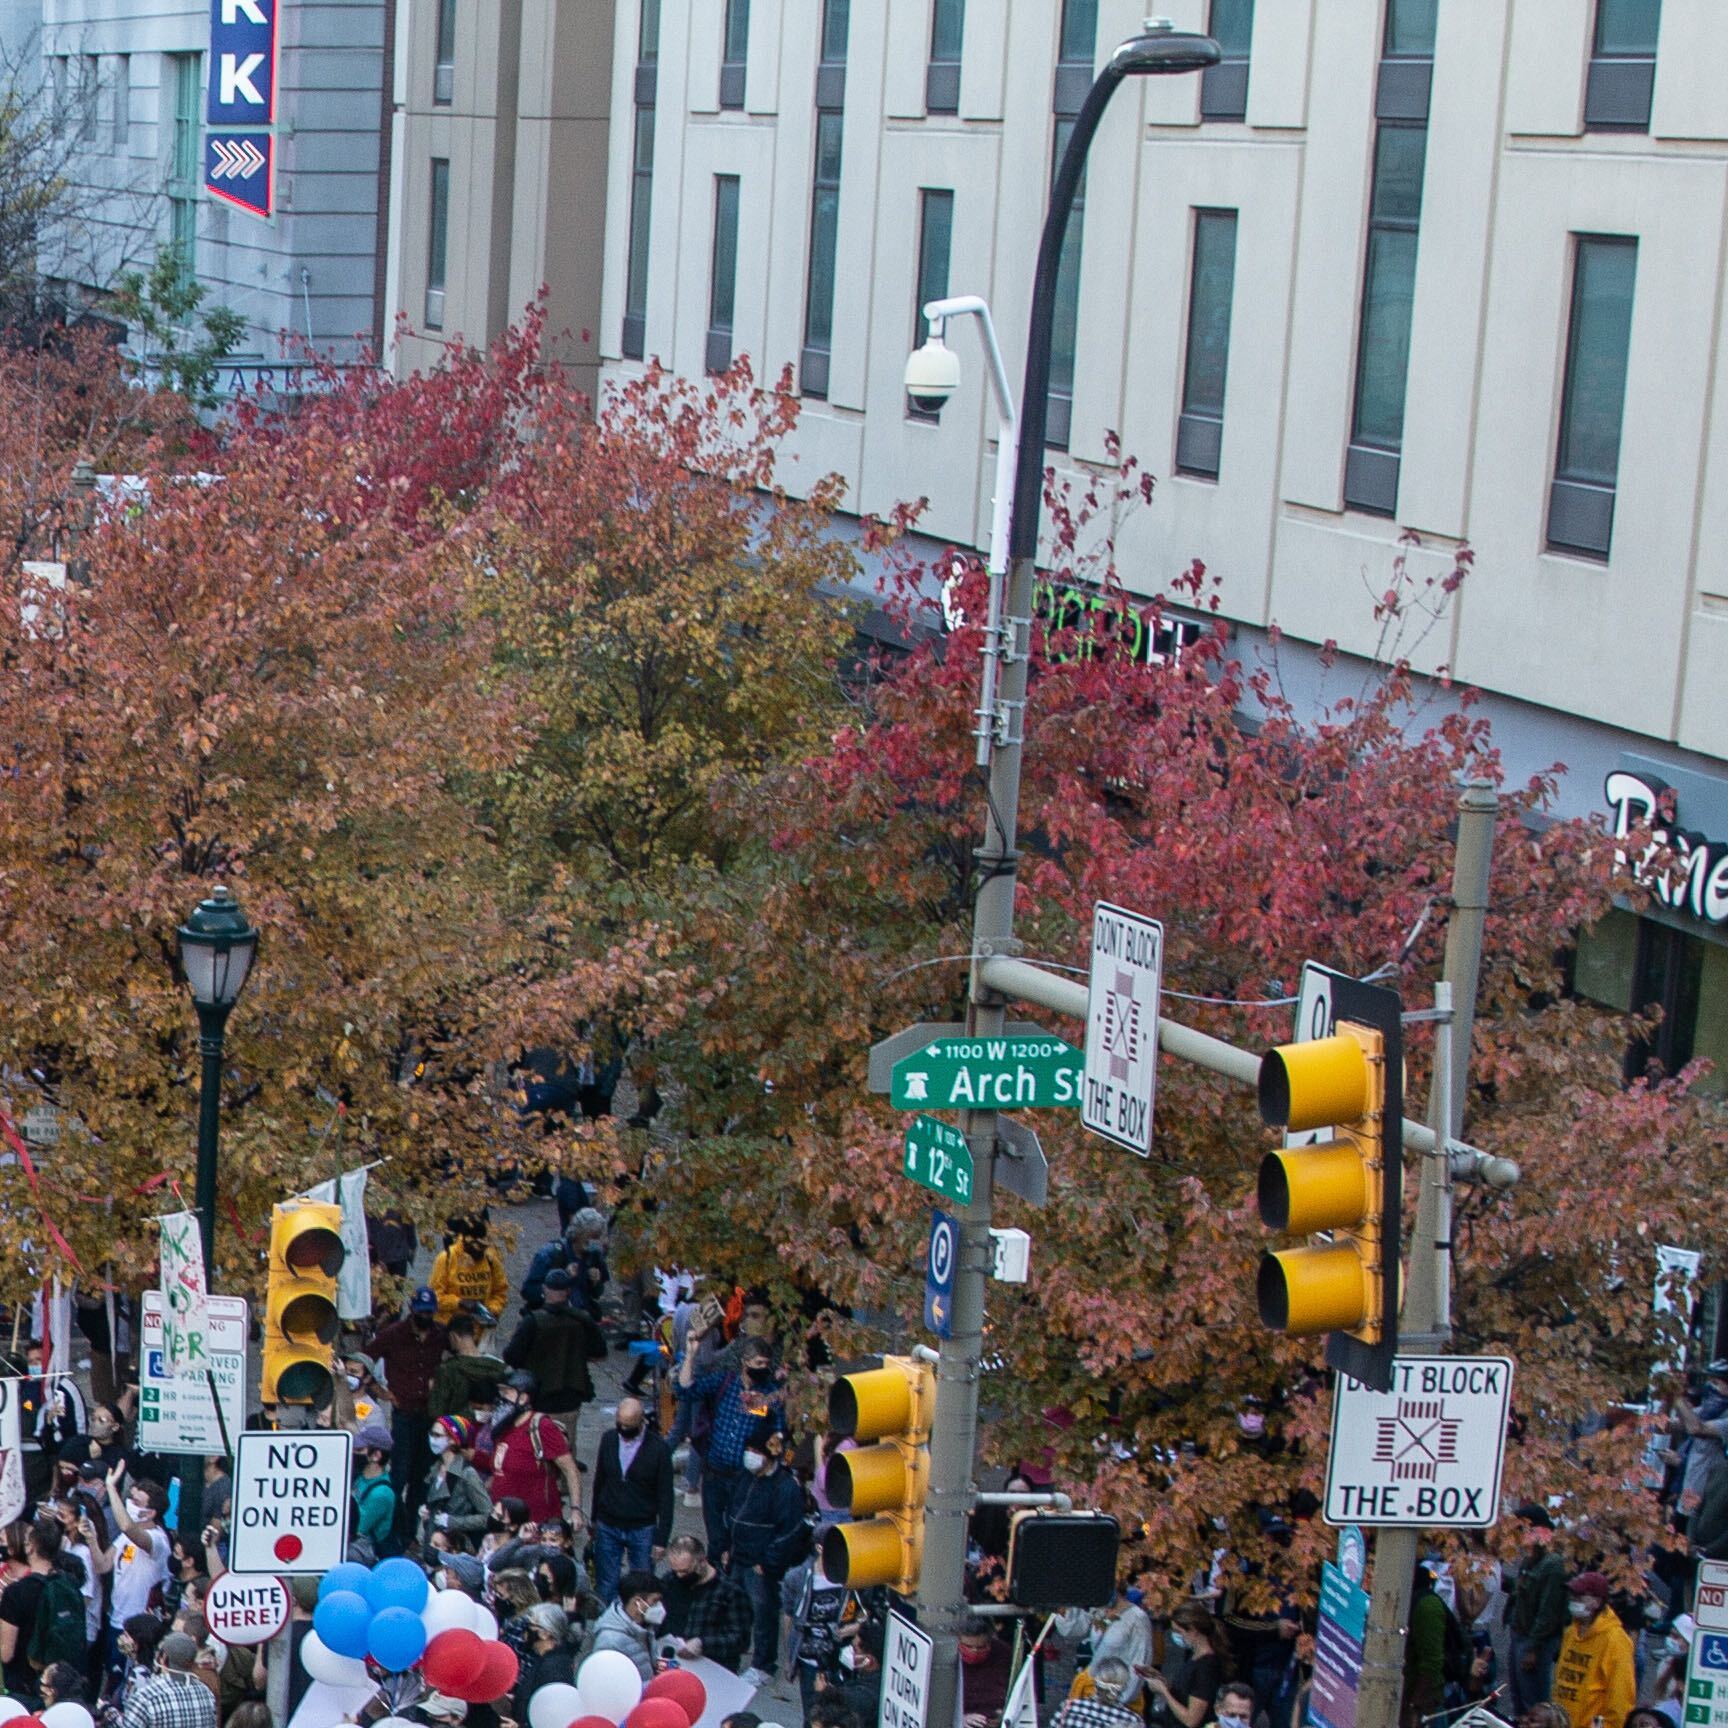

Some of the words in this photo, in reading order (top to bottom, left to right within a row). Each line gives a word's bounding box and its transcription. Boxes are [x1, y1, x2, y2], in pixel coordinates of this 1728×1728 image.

[1127, 925, 1160, 972] BLOCK
[946, 1045, 982, 1060] 1100
[987, 1042, 1005, 1060] W
[1011, 1044, 1050, 1059] 1200
[953, 1066, 1036, 1102] Arch
[1088, 1090, 1119, 1131] THE
[1121, 1103, 1147, 1145] BOX
[1420, 1366, 1499, 1396] BLOCK
[163, 1391, 177, 1401] HR
[163, 1410, 177, 1421] HR
[266, 1443, 318, 1470] NO
[255, 1476, 332, 1499] TURN
[1341, 1486, 1396, 1517] THE
[1415, 1486, 1482, 1519] BOX
[243, 1506, 282, 1528] ON
[290, 1506, 339, 1528] RED
[212, 1586, 282, 1611] UNITE
[1701, 1591, 1725, 1605] NO
[212, 1608, 281, 1630] HERE!
[897, 1634, 919, 1669] NO
[889, 1666, 920, 1708] TURN
[883, 1698, 900, 1725] ON
